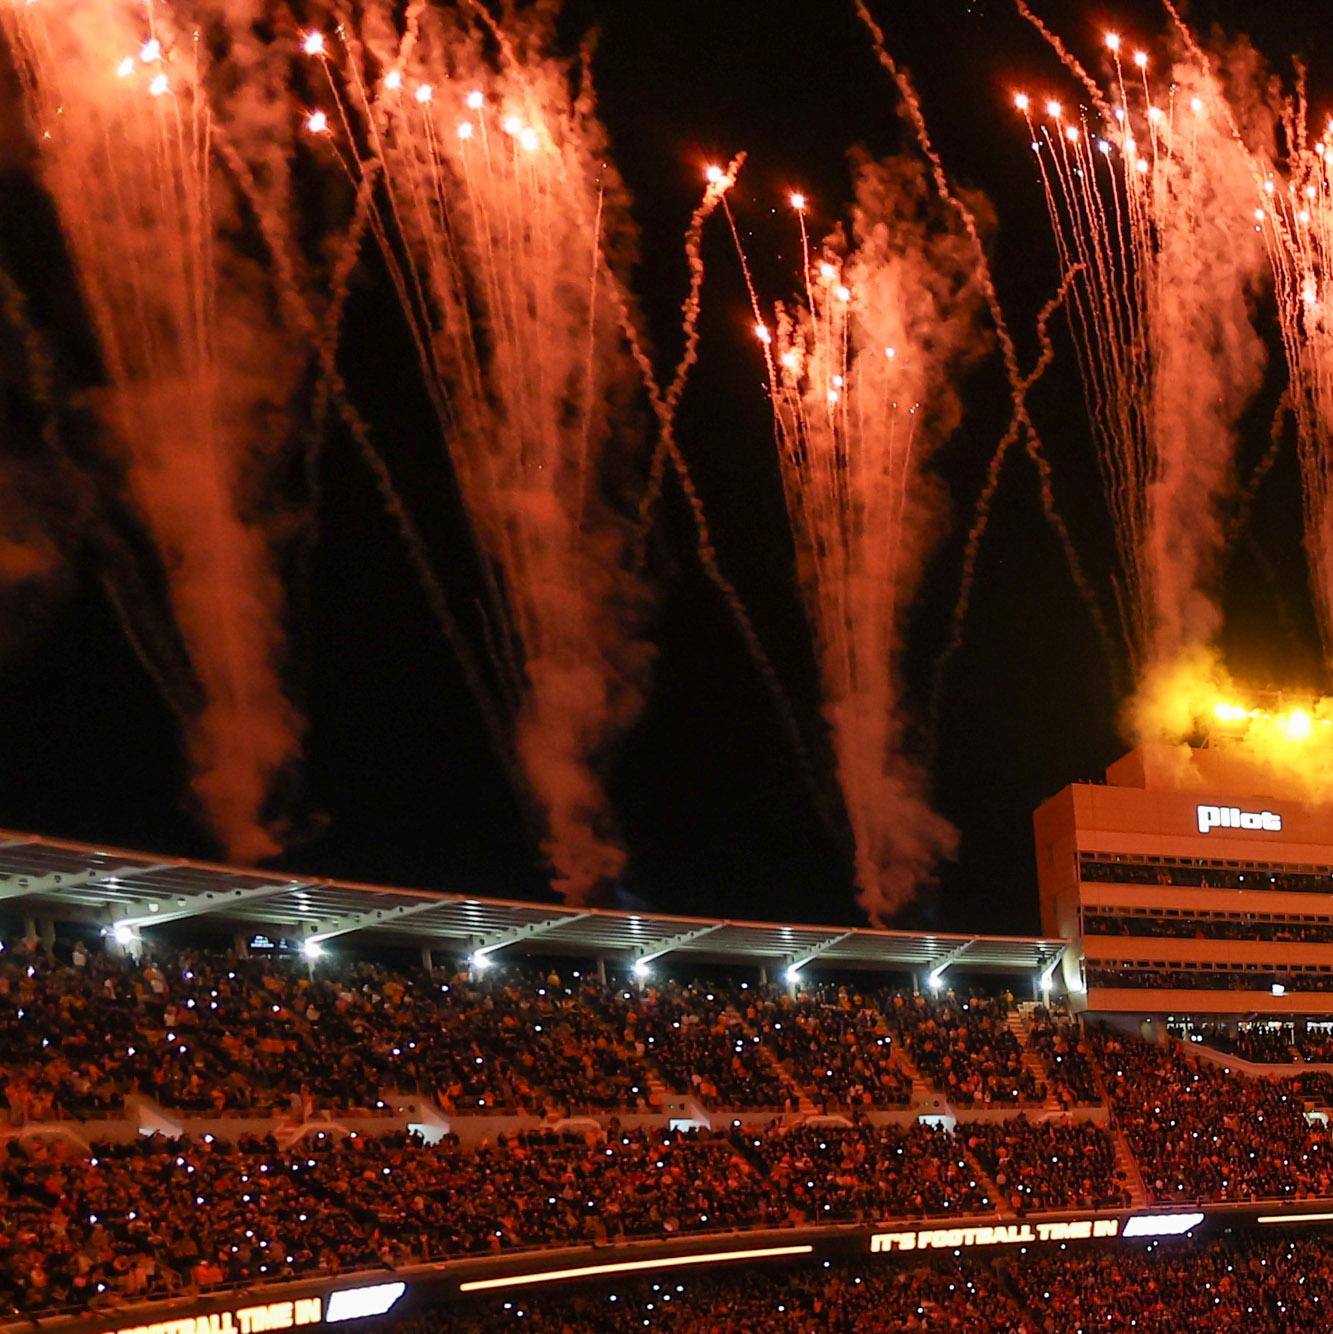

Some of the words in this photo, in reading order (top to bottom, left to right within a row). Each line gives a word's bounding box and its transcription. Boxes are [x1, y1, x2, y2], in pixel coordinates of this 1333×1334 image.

[870, 1232, 916, 1253] IT'S
[918, 1224, 1036, 1249] FOOTBALL
[1037, 1221, 1092, 1241] TIME
[1093, 1219, 1118, 1237] IN
[237, 1302, 294, 1334] TIME
[294, 1297, 322, 1325] IN
